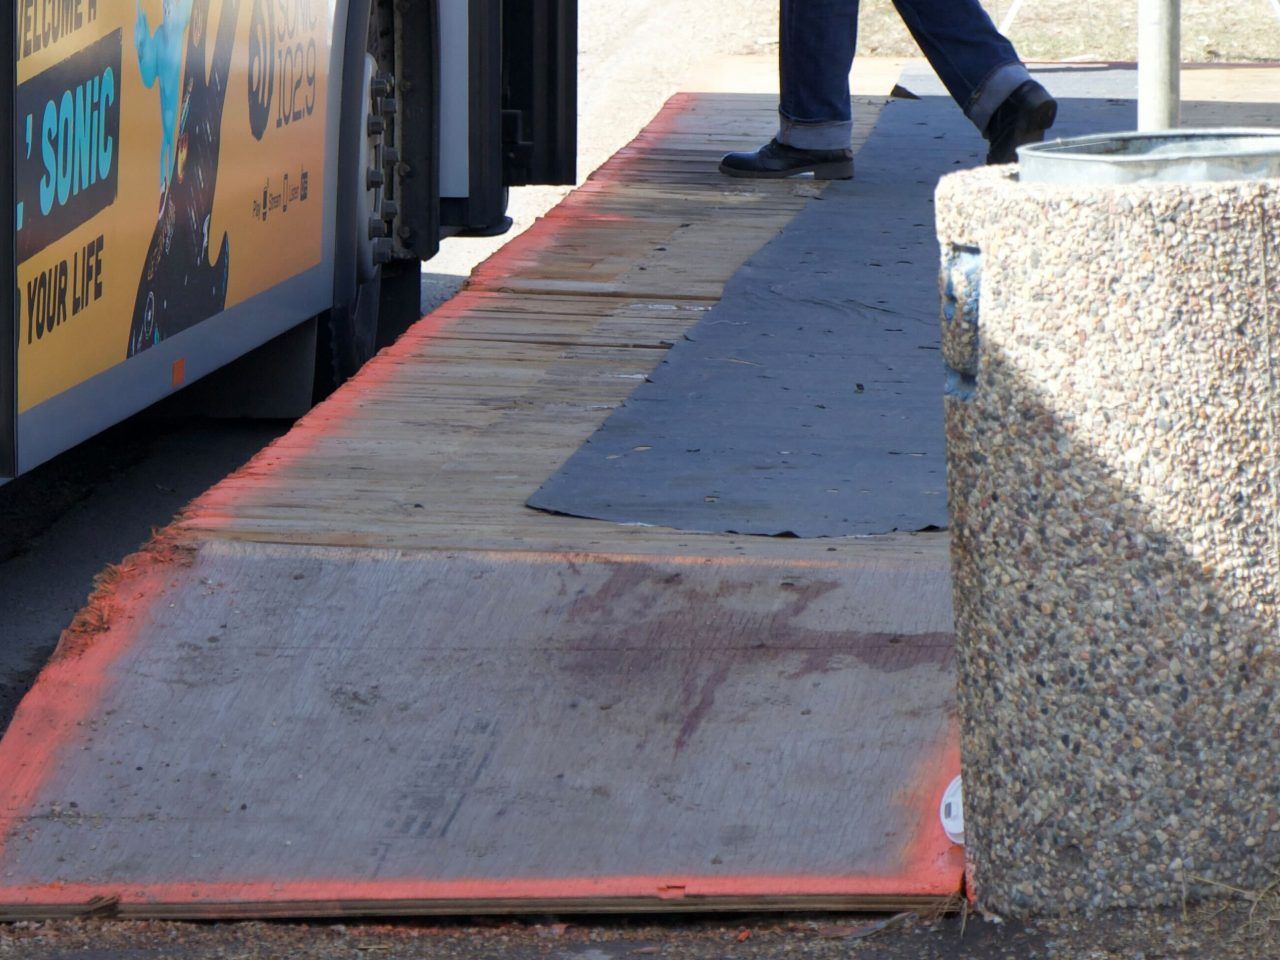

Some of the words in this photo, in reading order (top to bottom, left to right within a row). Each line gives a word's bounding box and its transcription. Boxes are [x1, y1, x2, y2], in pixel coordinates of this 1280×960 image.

[276, 37, 316, 129] 102.9
[27, 260, 67, 345] YOUR
[72, 234, 104, 317] LIFE
